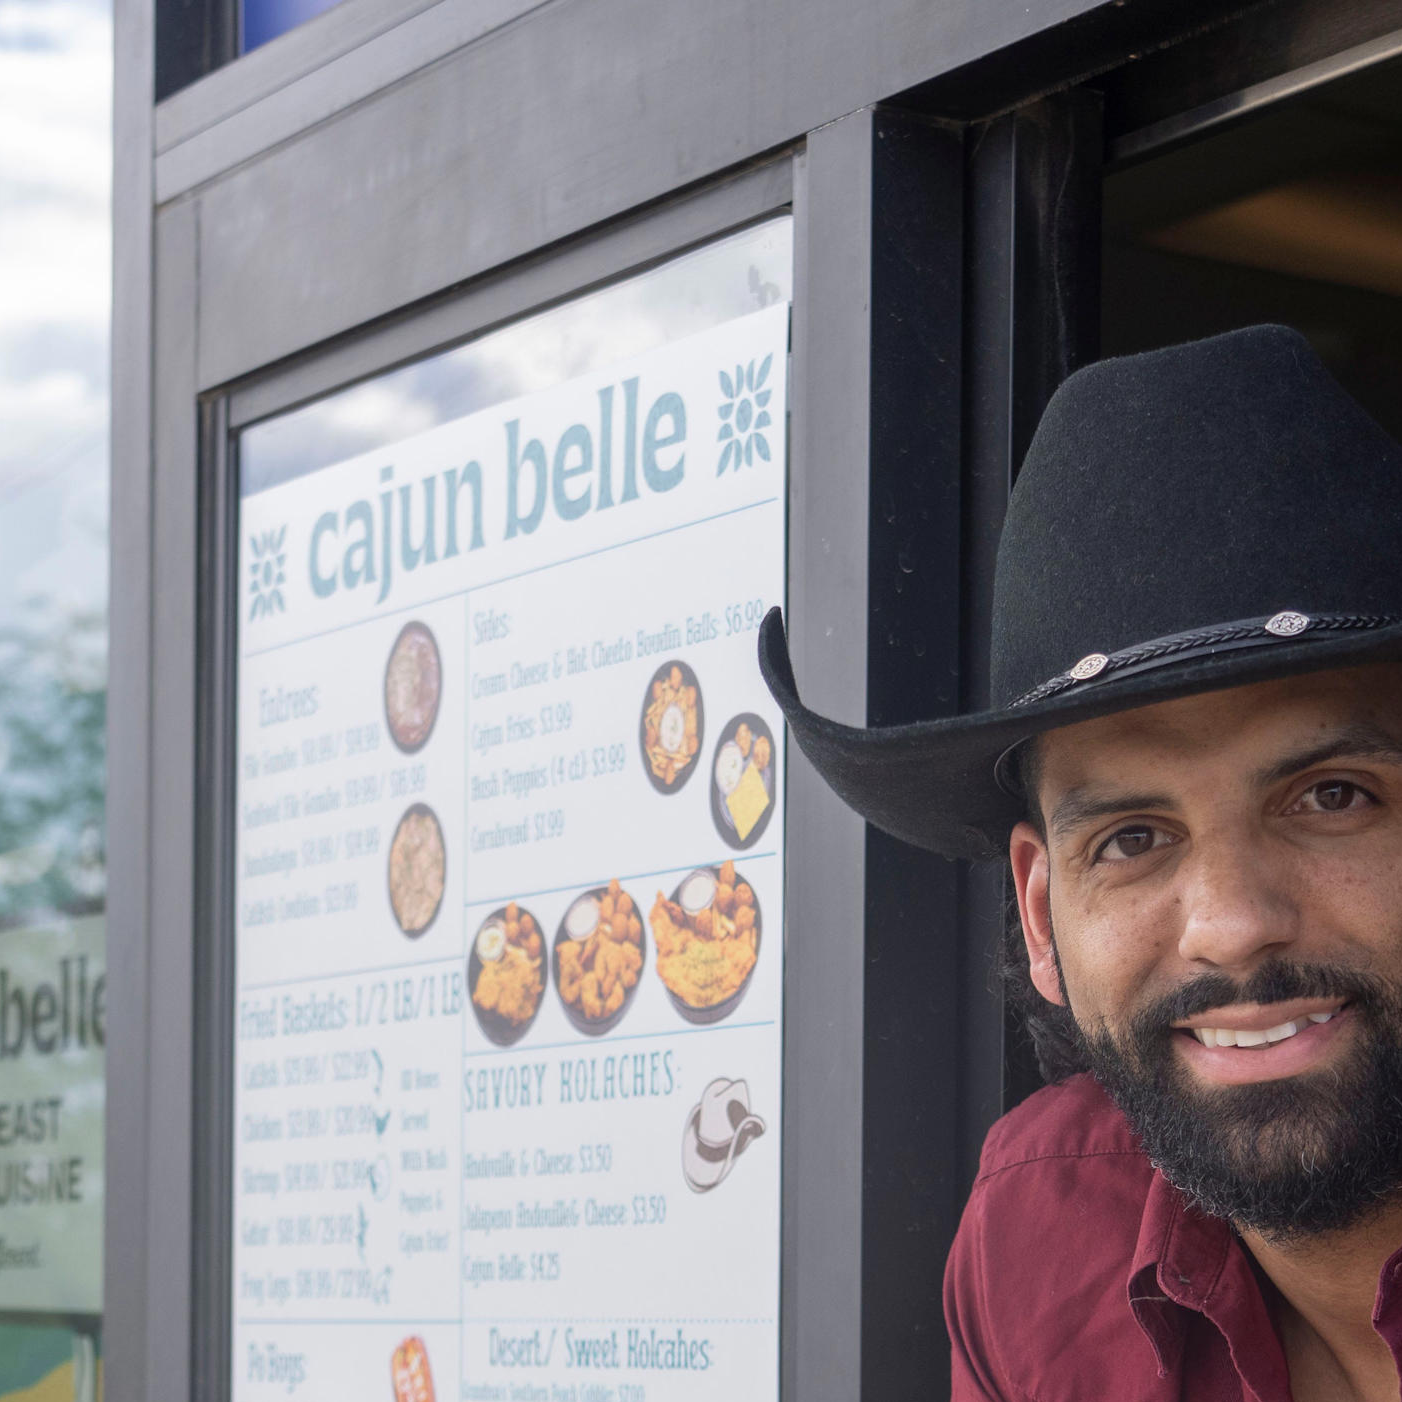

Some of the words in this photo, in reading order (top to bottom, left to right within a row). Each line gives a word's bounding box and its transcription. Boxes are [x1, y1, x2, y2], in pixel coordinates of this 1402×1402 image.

[307, 458, 486, 606] cajun
[502, 375, 689, 542] belle
[510, 660, 550, 690] Cheese
[566, 645, 588, 676] Hot
[636, 623, 683, 658] Boudin
[725, 597, 764, 638] $6.99
[282, 991, 349, 1037] Baskets
[462, 1062, 547, 1113] SAVORY
[564, 1325, 620, 1369] Sweet
